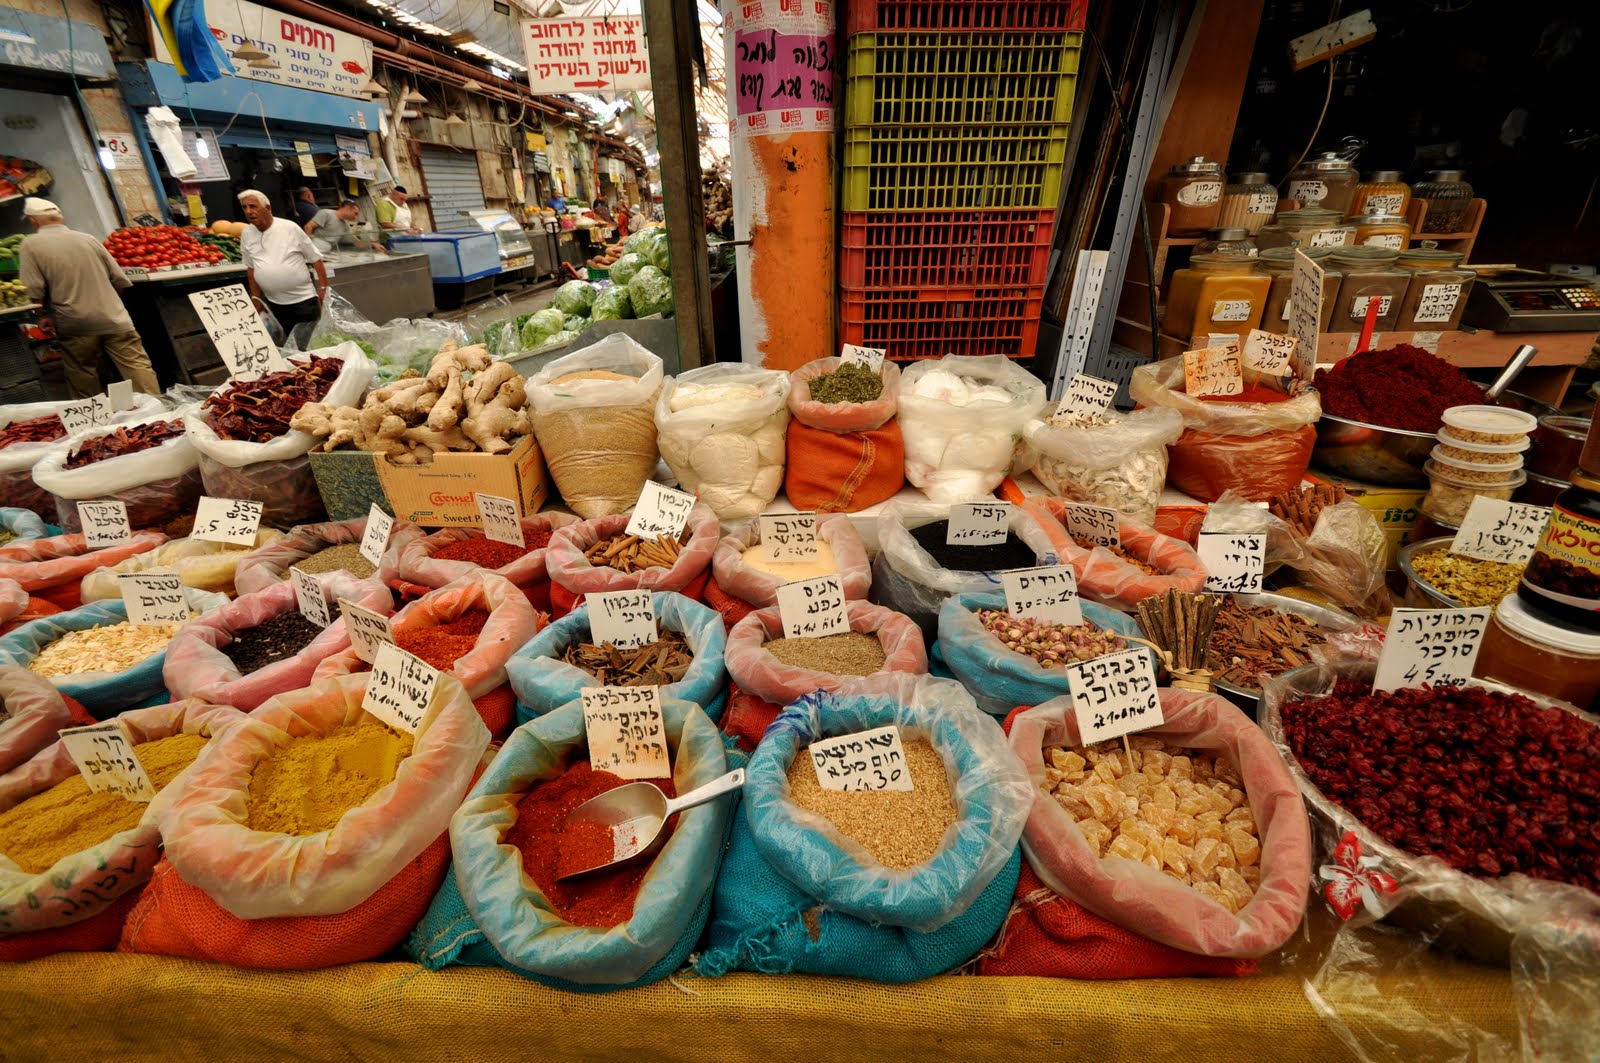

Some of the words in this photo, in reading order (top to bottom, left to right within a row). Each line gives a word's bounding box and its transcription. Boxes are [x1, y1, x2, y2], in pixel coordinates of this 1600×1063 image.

[280, 19, 335, 52] רחמים
[530, 21, 585, 38] לרחוב
[593, 20, 640, 36] יציאה
[231, 34, 277, 54] הדם
[539, 42, 584, 57] יהודה
[593, 40, 637, 55] מחנה
[286, 48, 310, 61] סוגי
[318, 53, 333, 67] כל
[534, 62, 590, 79] העירקי
[598, 59, 647, 77] ולשוק
[307, 80, 325, 88] חיים
[335, 73, 359, 85] טריים
[741, 73, 764, 112] קודש
[771, 76, 801, 99] שבת
[200, 287, 242, 303] פלפל
[203, 299, 248, 325] מתוק
[1071, 379, 1115, 397] פטריות
[443, 514, 472, 522] Sweet
[774, 519, 815, 533] שום
[1225, 554, 1261, 567] הודי
[803, 580, 839, 597] אניס
[140, 595, 182, 606] שום
[1398, 613, 1485, 633] חמוציות
[1420, 643, 1473, 659] סוכר
[1148, 694, 1156, 709] 6
[871, 751, 900, 767] חום
[827, 759, 867, 779] מלא
